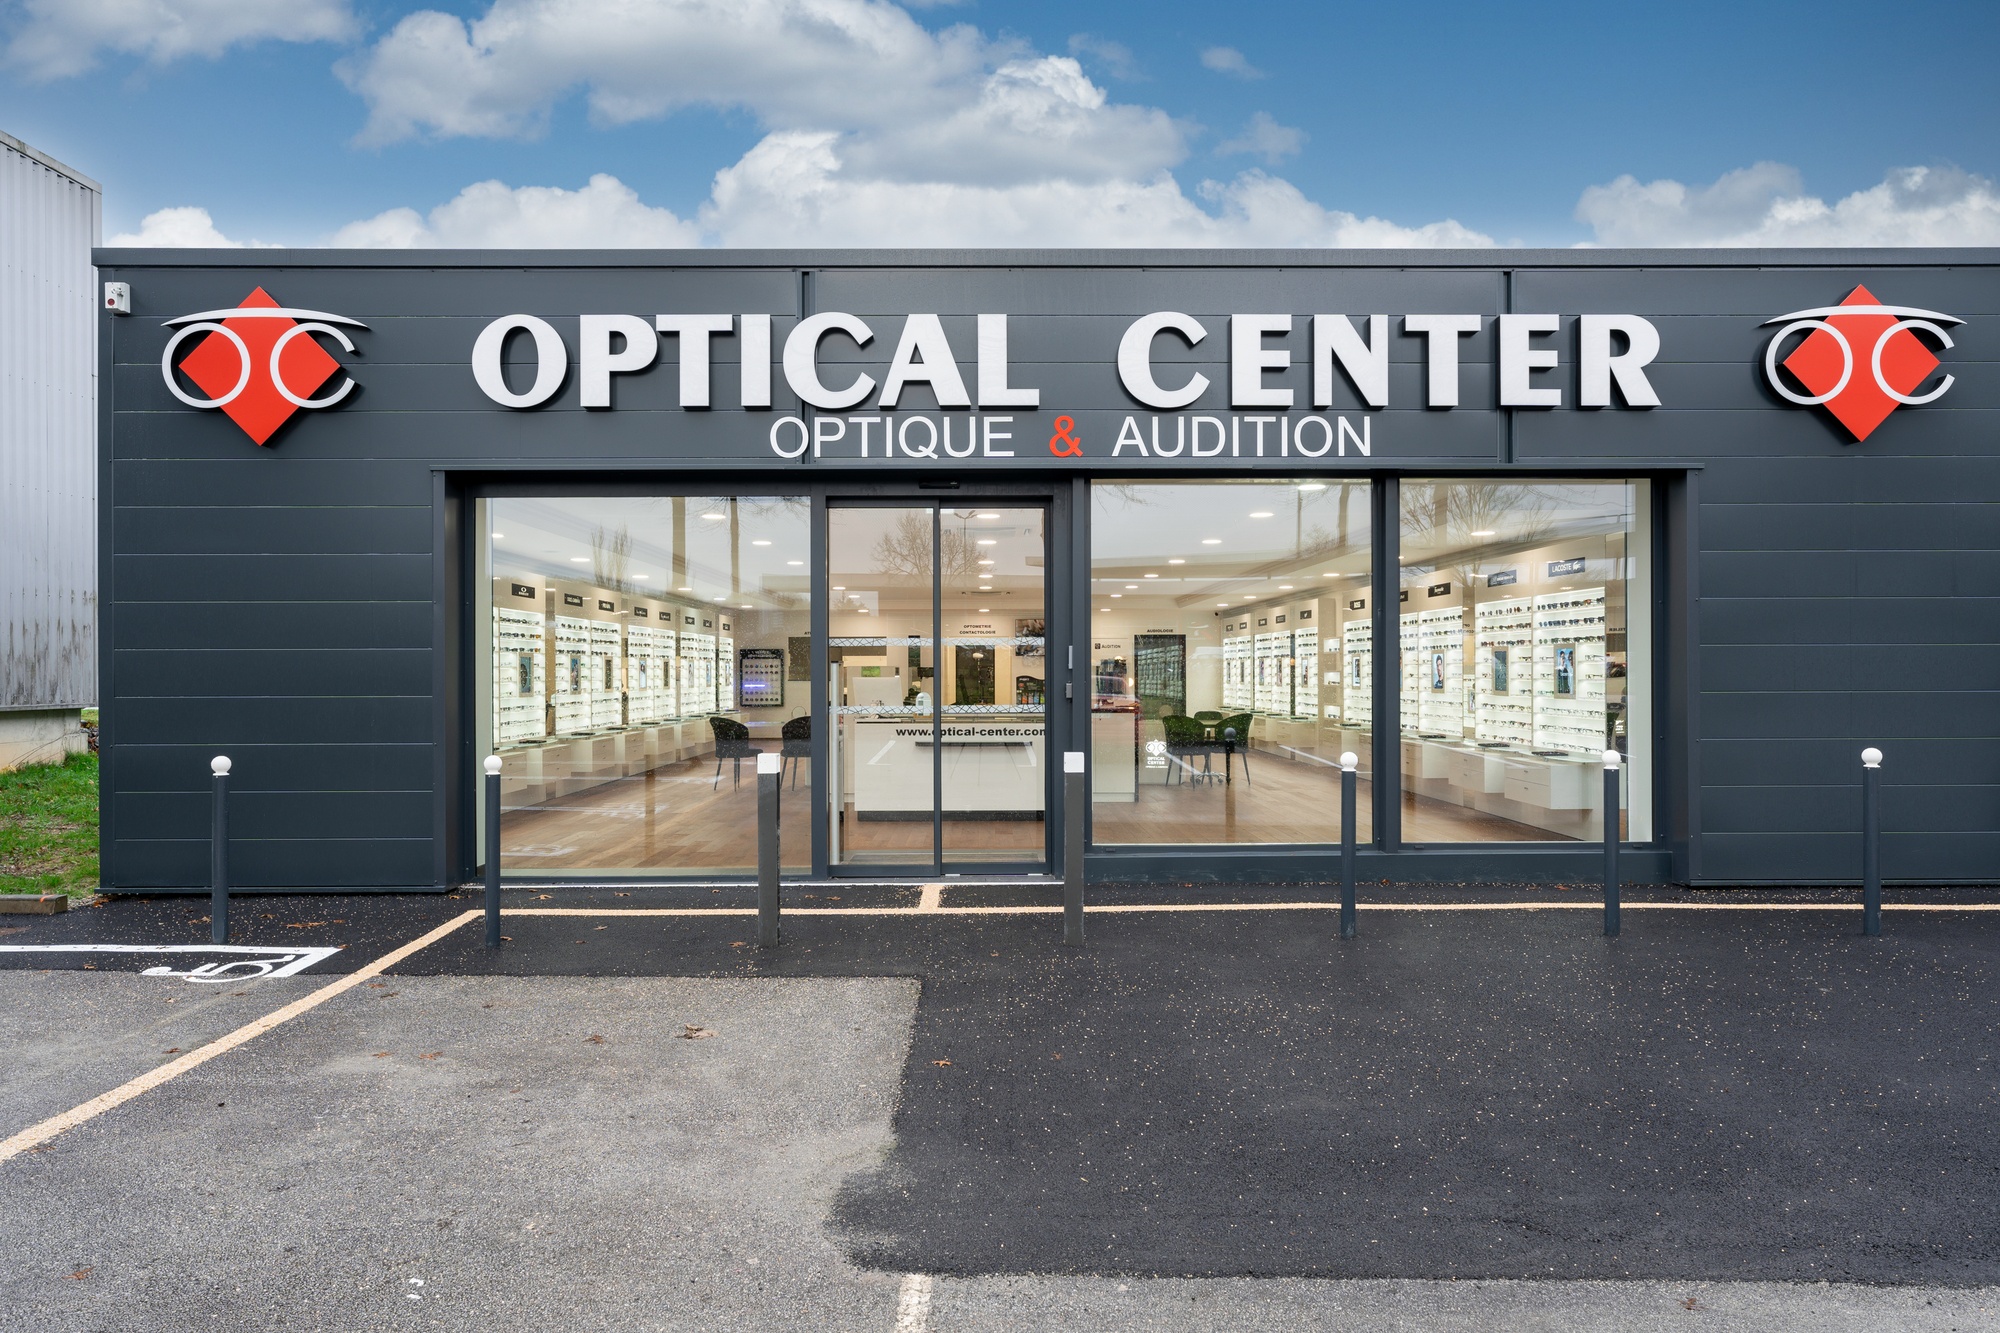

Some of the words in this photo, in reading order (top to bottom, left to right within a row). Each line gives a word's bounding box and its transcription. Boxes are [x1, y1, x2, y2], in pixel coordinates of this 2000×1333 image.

[471, 312, 1040, 409] OPTICAL
[1117, 311, 1663, 409] CENTER
[769, 416, 1015, 459] OPTIQUE
[1048, 415, 1083, 458] &
[1111, 416, 1371, 458] AUDITION
[1551, 563, 1572, 573] LACOSTE
